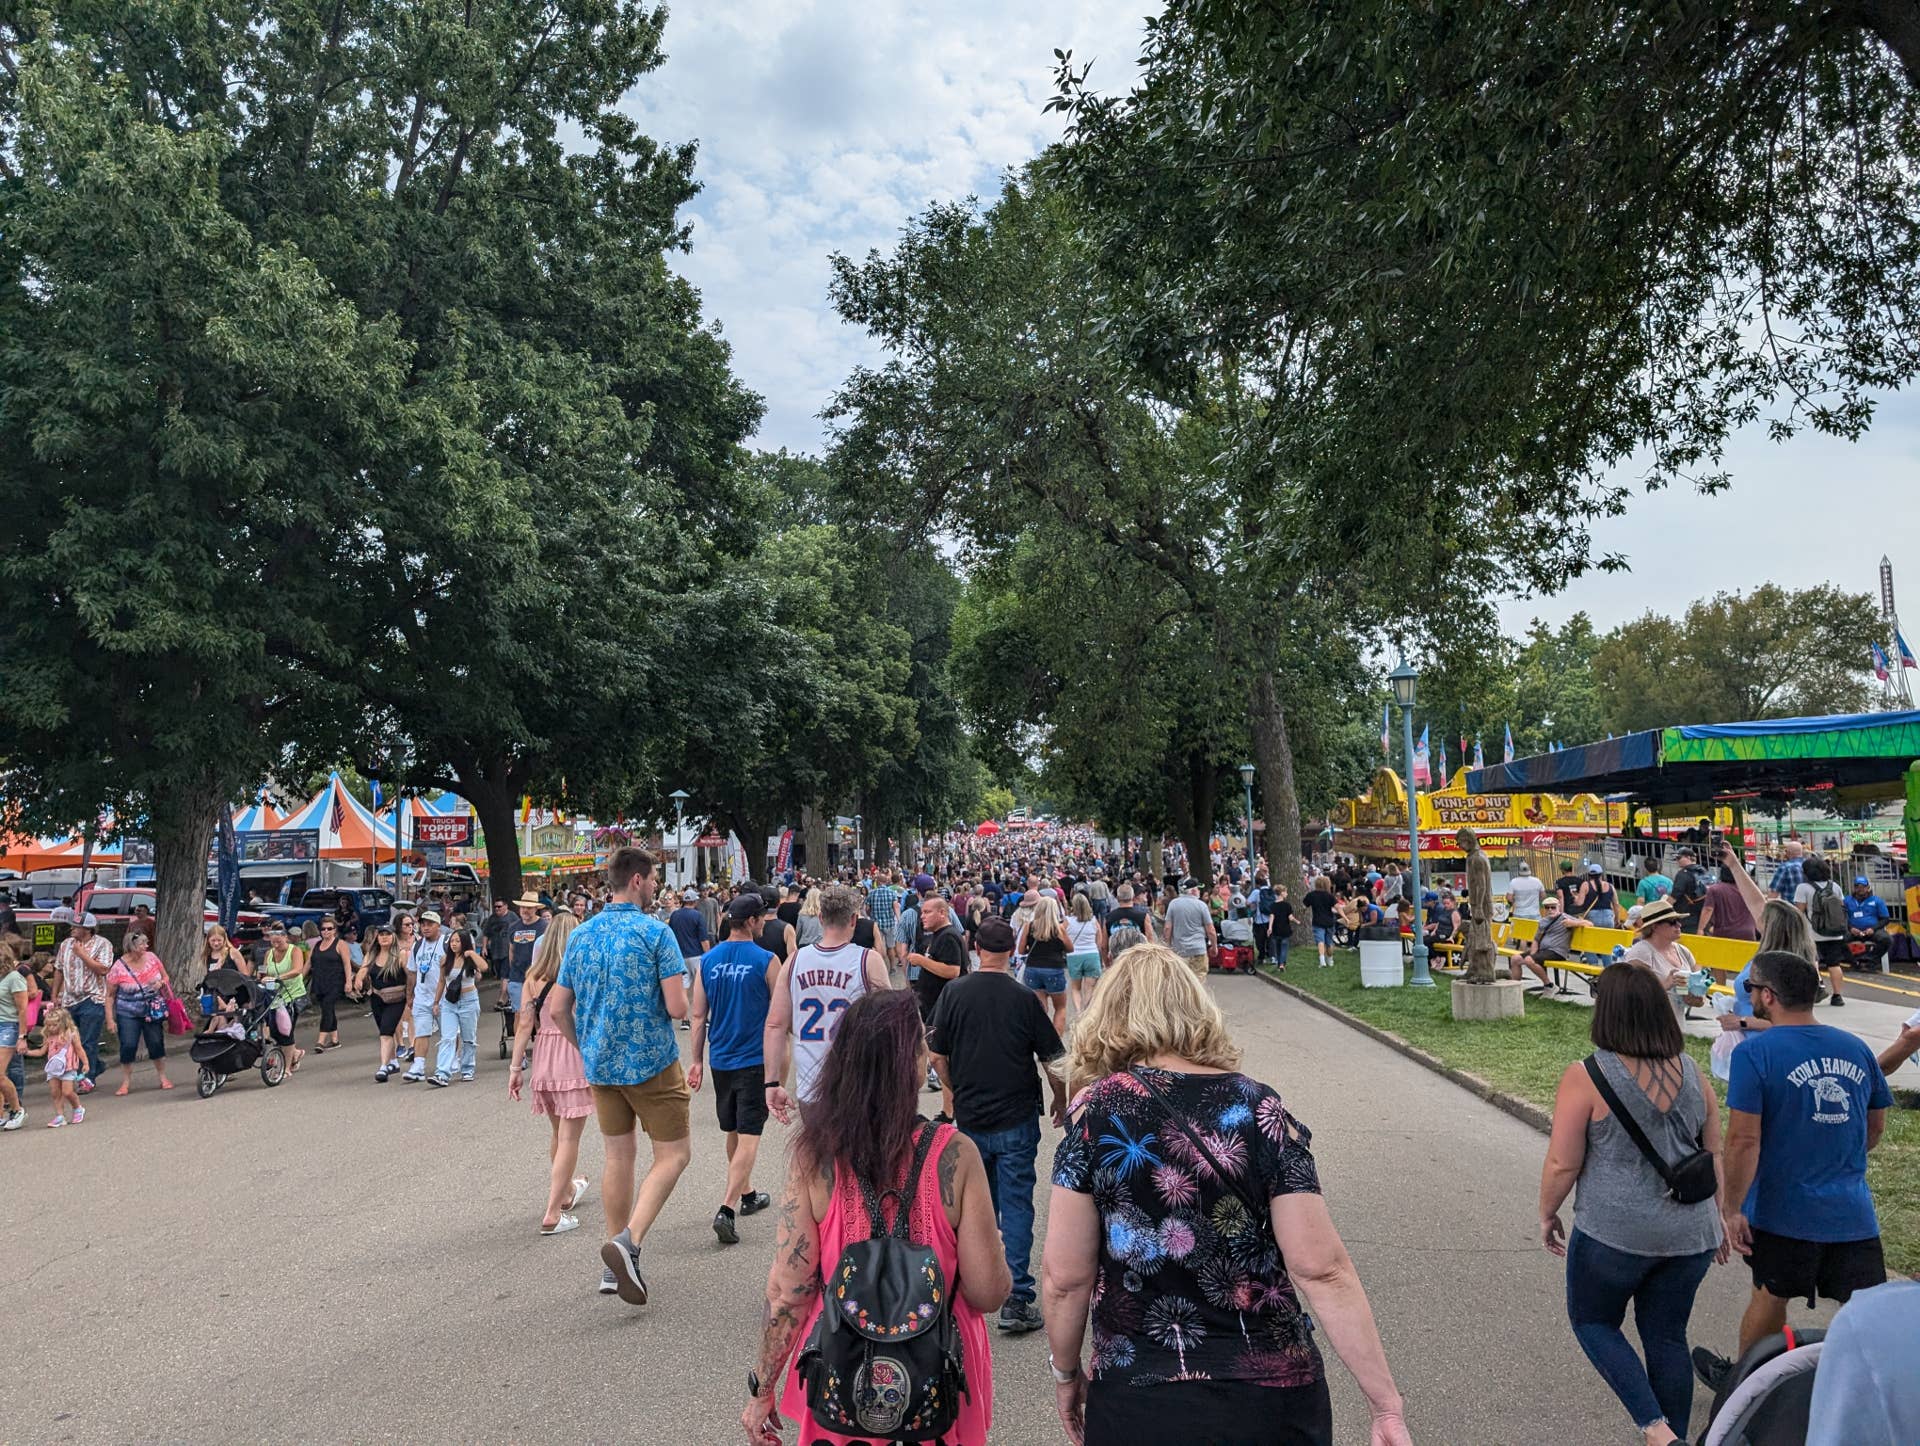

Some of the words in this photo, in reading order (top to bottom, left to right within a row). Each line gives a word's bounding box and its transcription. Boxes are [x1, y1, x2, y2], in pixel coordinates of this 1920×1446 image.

[1433, 796, 1510, 809] MINI-DONUT
[1441, 809, 1505, 822] FACTORY
[421, 824, 466, 832] TOPPER
[429, 833, 458, 841] SALE
[1479, 836, 1521, 847] DONUTS
[710, 962, 753, 983] STAFF
[797, 969, 852, 991] MURRAY
[1787, 1059, 1821, 1088] KONA
[1820, 1057, 1866, 1085] HAWAII
